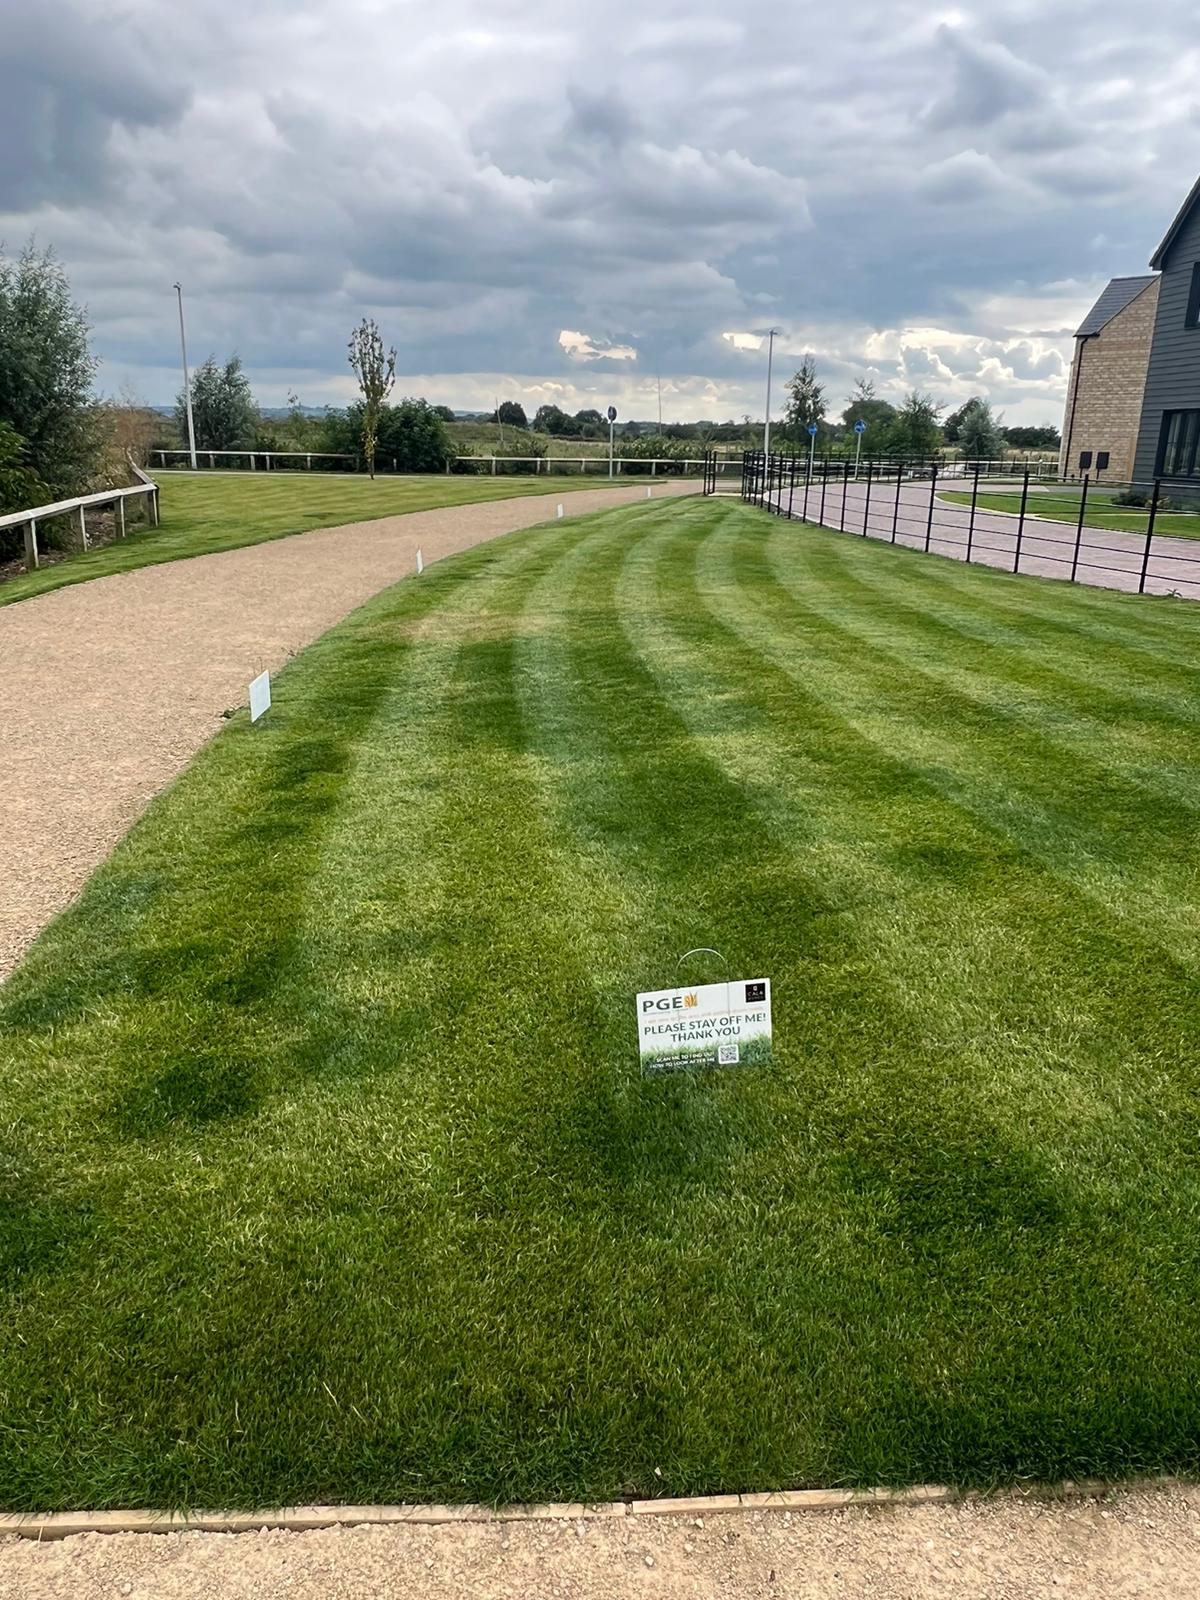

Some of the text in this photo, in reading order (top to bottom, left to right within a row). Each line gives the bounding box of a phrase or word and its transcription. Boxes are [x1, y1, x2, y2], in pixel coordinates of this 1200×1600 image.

[642, 996, 683, 1013] PGE
[644, 1022, 686, 1035] PLEASE
[689, 1018, 717, 1030] STAY
[720, 1015, 742, 1026] OFF
[745, 1012, 766, 1023] ME!
[670, 1026, 741, 1042] THANK YOU
